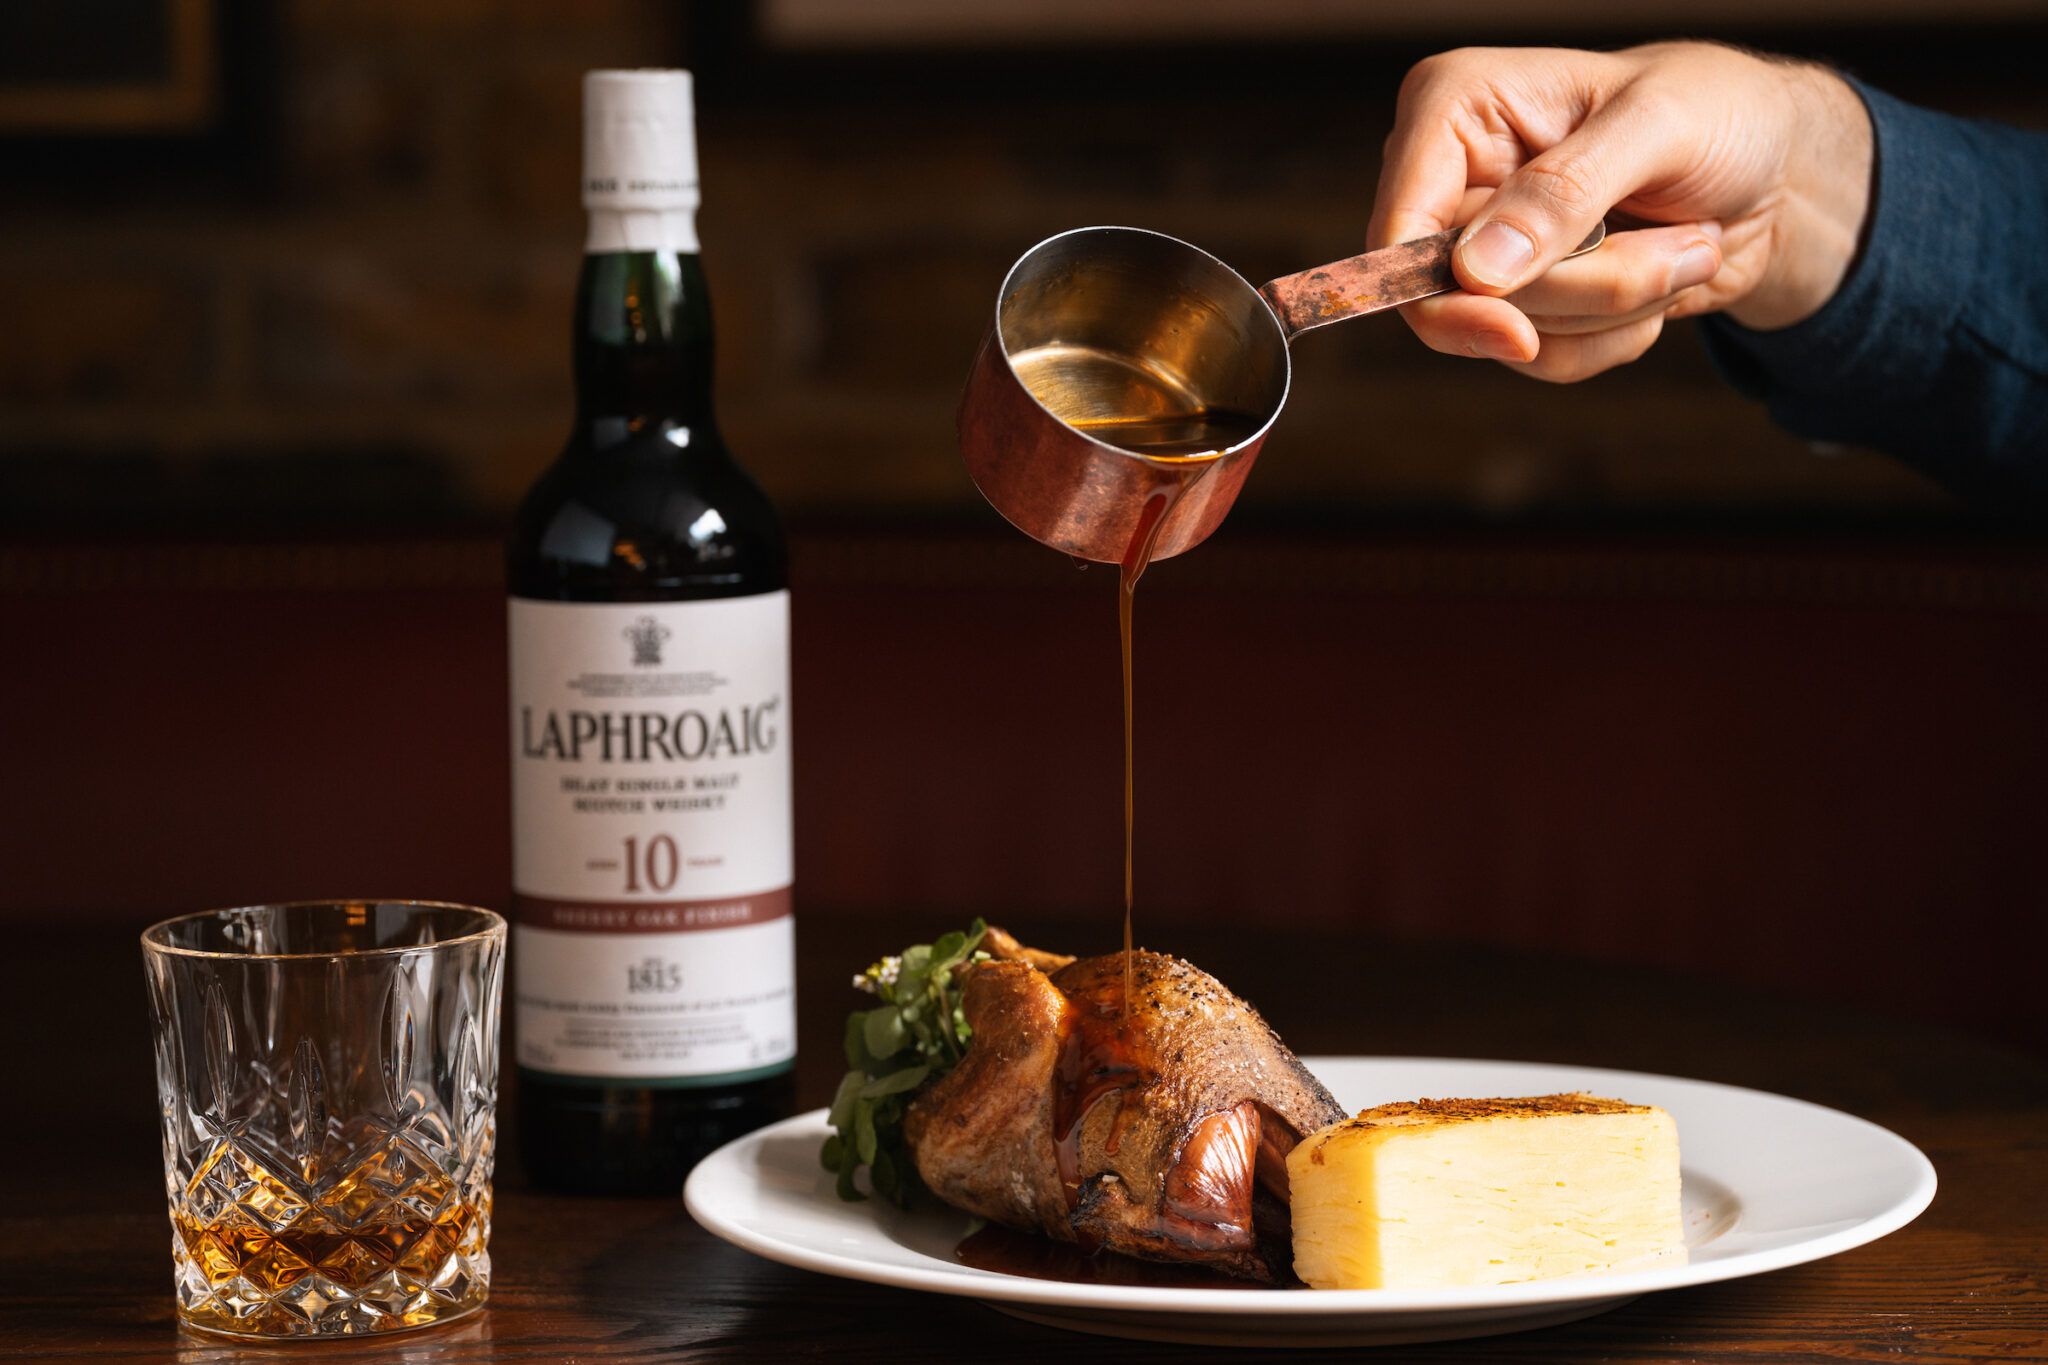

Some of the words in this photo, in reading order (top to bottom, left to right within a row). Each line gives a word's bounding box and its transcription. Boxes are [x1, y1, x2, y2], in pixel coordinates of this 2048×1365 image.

[622, 832, 679, 895] 10
[634, 909, 679, 926] OAK
[627, 964, 683, 994] 1815
